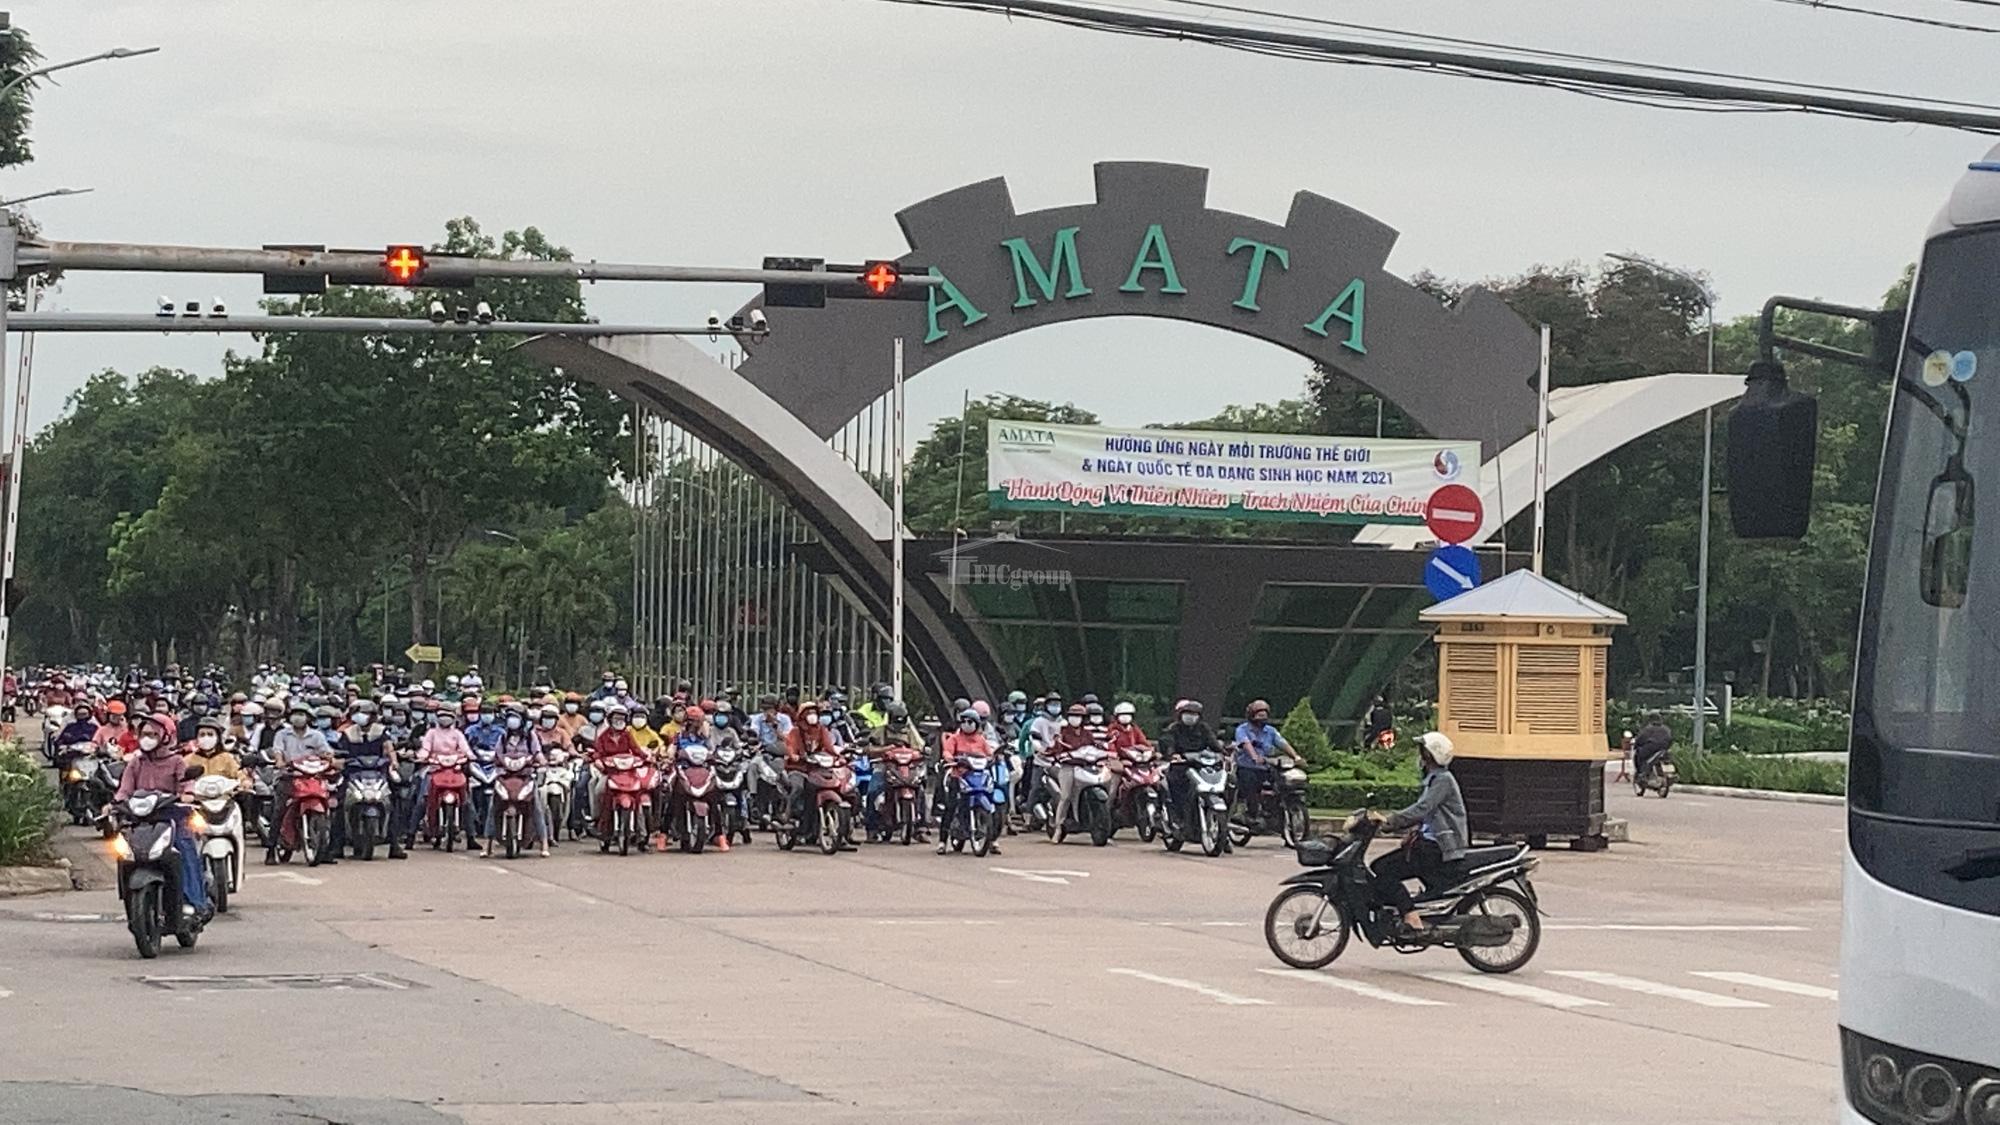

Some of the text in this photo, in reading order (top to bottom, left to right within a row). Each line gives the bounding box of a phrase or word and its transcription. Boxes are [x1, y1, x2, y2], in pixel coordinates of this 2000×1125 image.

[925, 224, 1368, 353] AMATA
[998, 428, 1056, 443] AMATA
[1082, 460, 1092, 472] &
[1260, 468, 1291, 481] SINH
[1362, 471, 1393, 485] 2021
